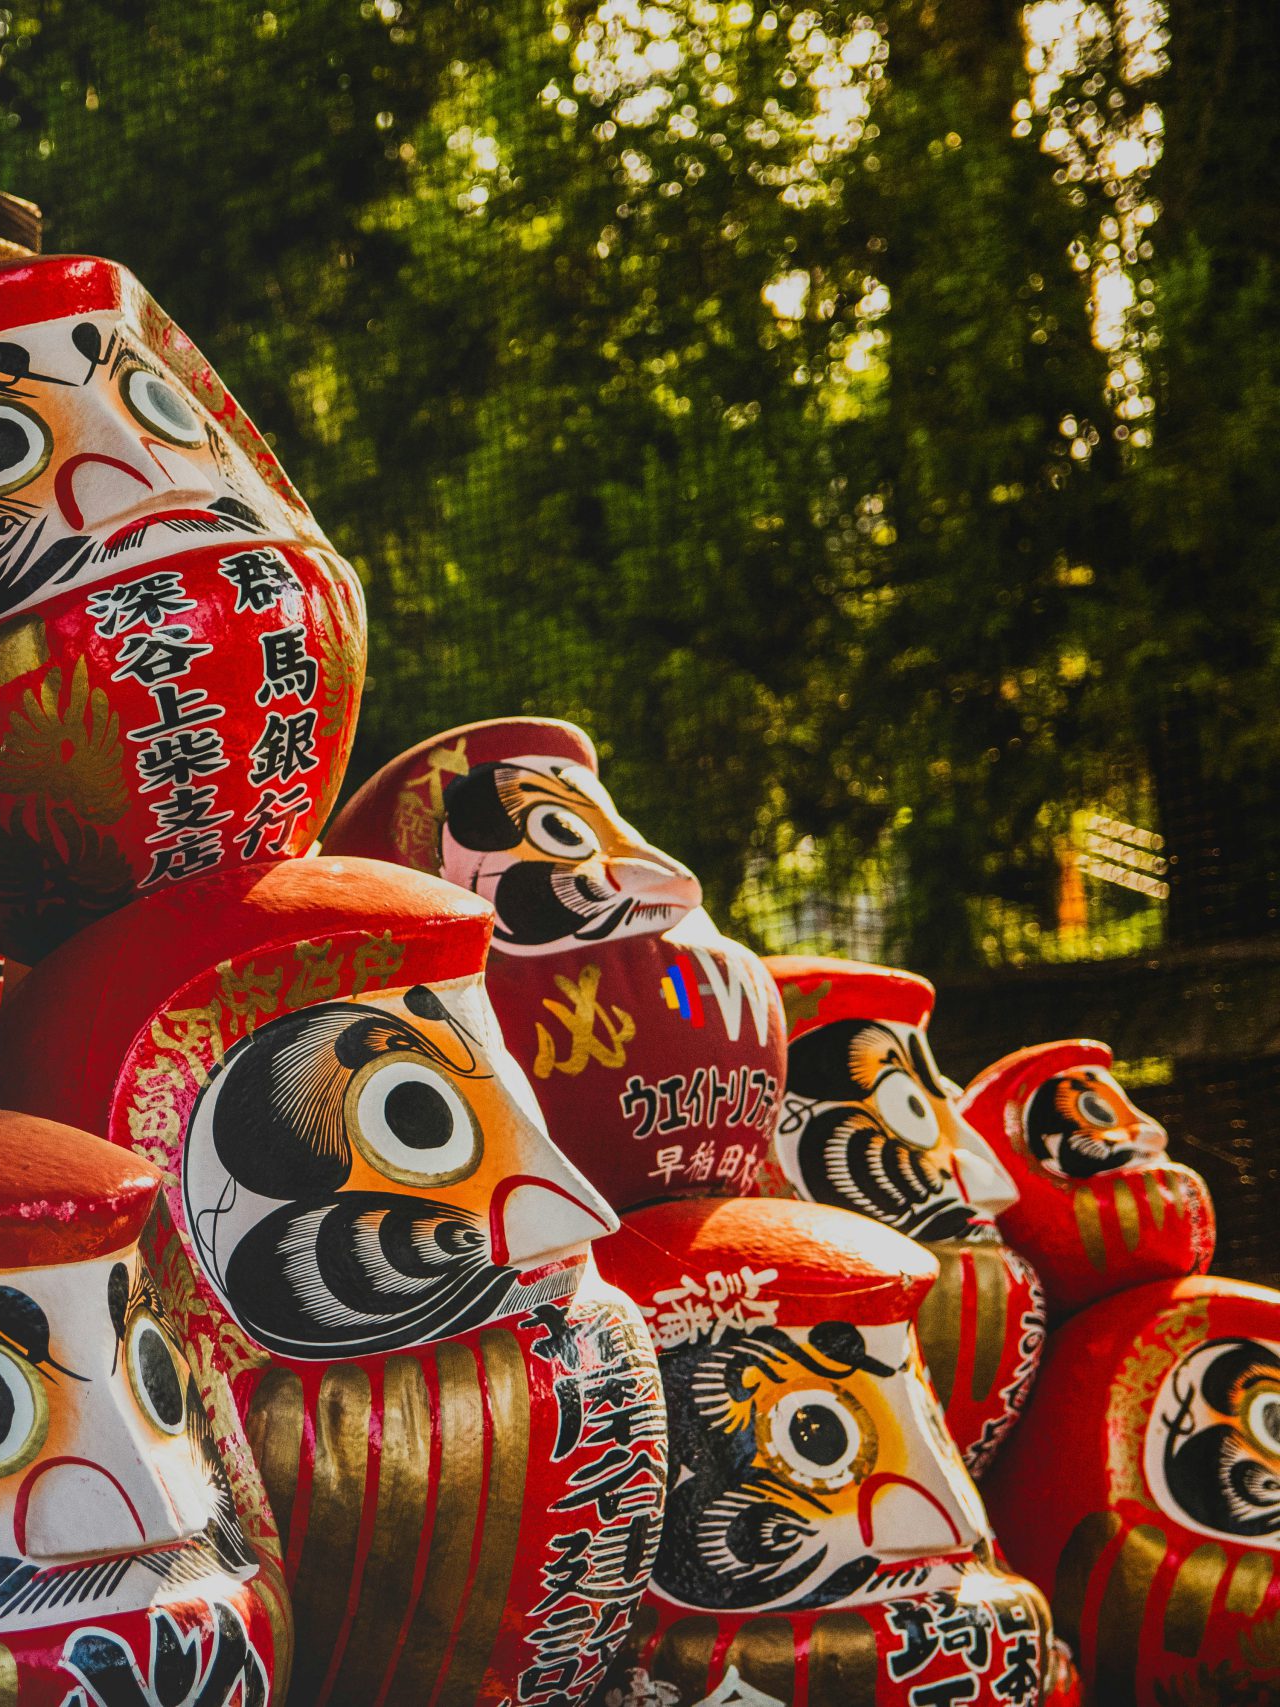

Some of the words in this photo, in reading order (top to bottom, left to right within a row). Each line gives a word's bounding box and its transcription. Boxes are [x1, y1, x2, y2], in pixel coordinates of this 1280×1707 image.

[86, 571, 234, 888] 深谷上柴支店
[218, 547, 319, 859] 群馬銀行
[533, 964, 636, 1078] 必
